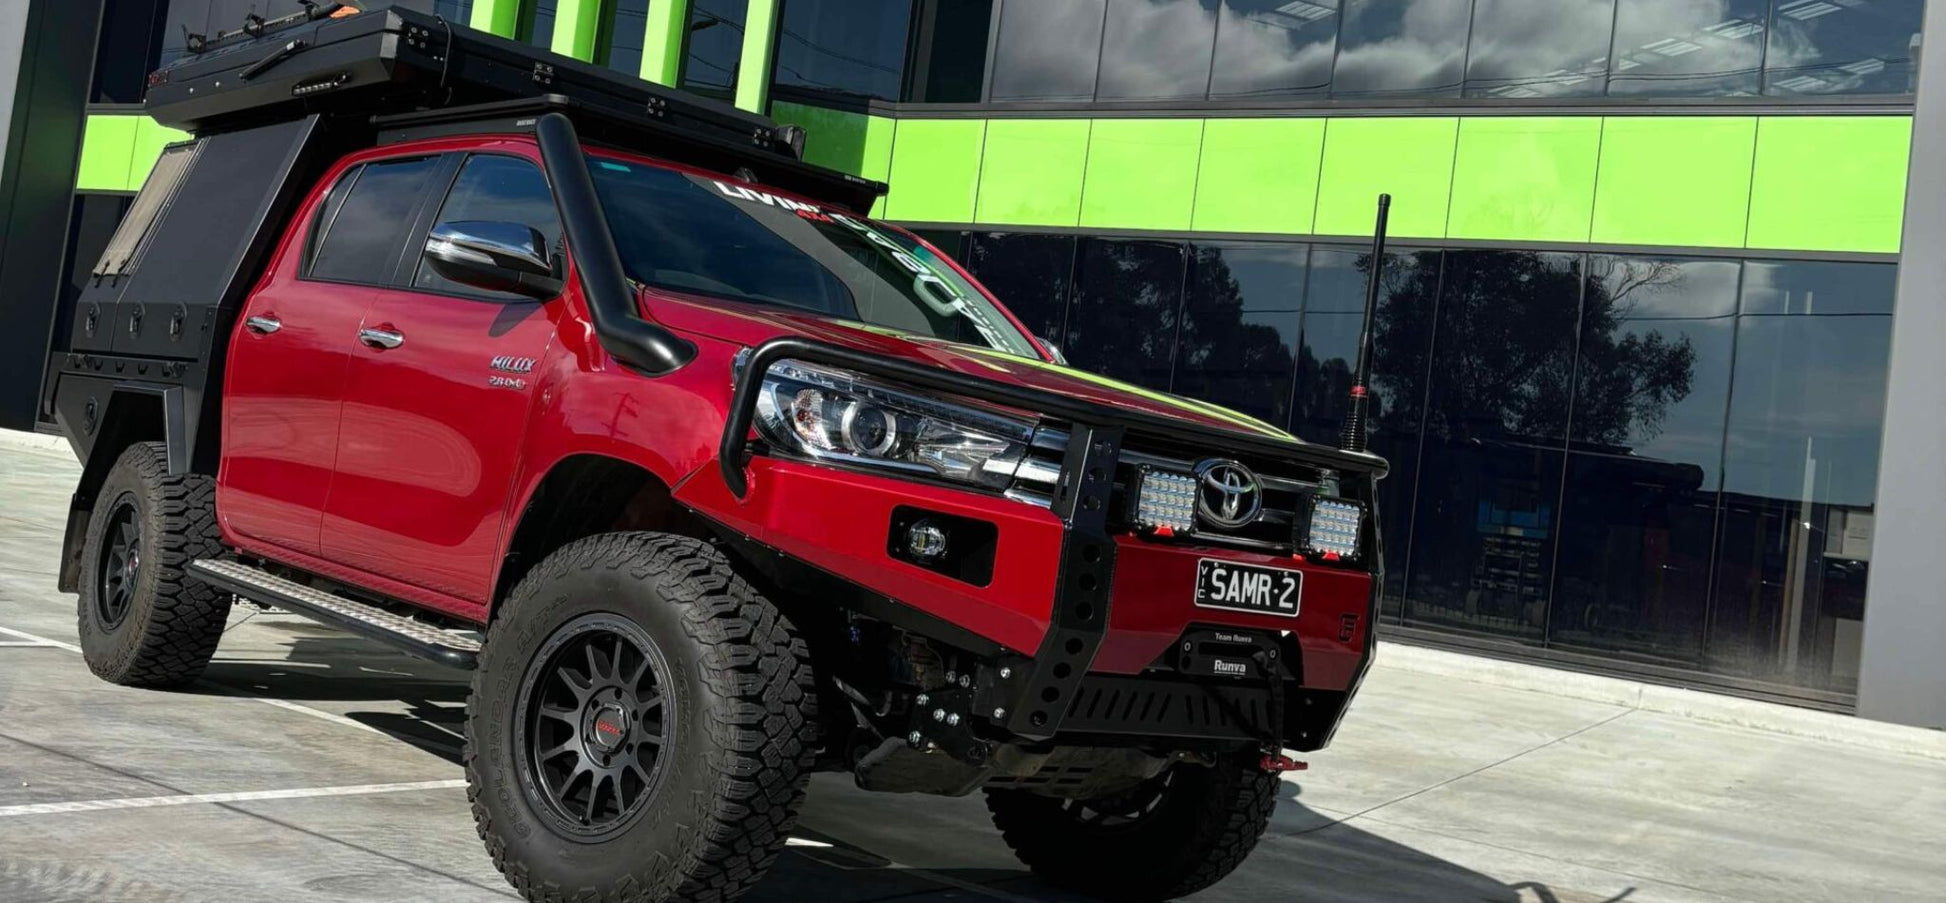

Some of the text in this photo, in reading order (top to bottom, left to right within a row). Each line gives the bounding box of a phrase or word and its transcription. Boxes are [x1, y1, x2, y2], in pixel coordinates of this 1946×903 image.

[490, 356, 536, 371] HILUX
[1215, 632, 1232, 641] Team
[1214, 659, 1246, 673] Runva
